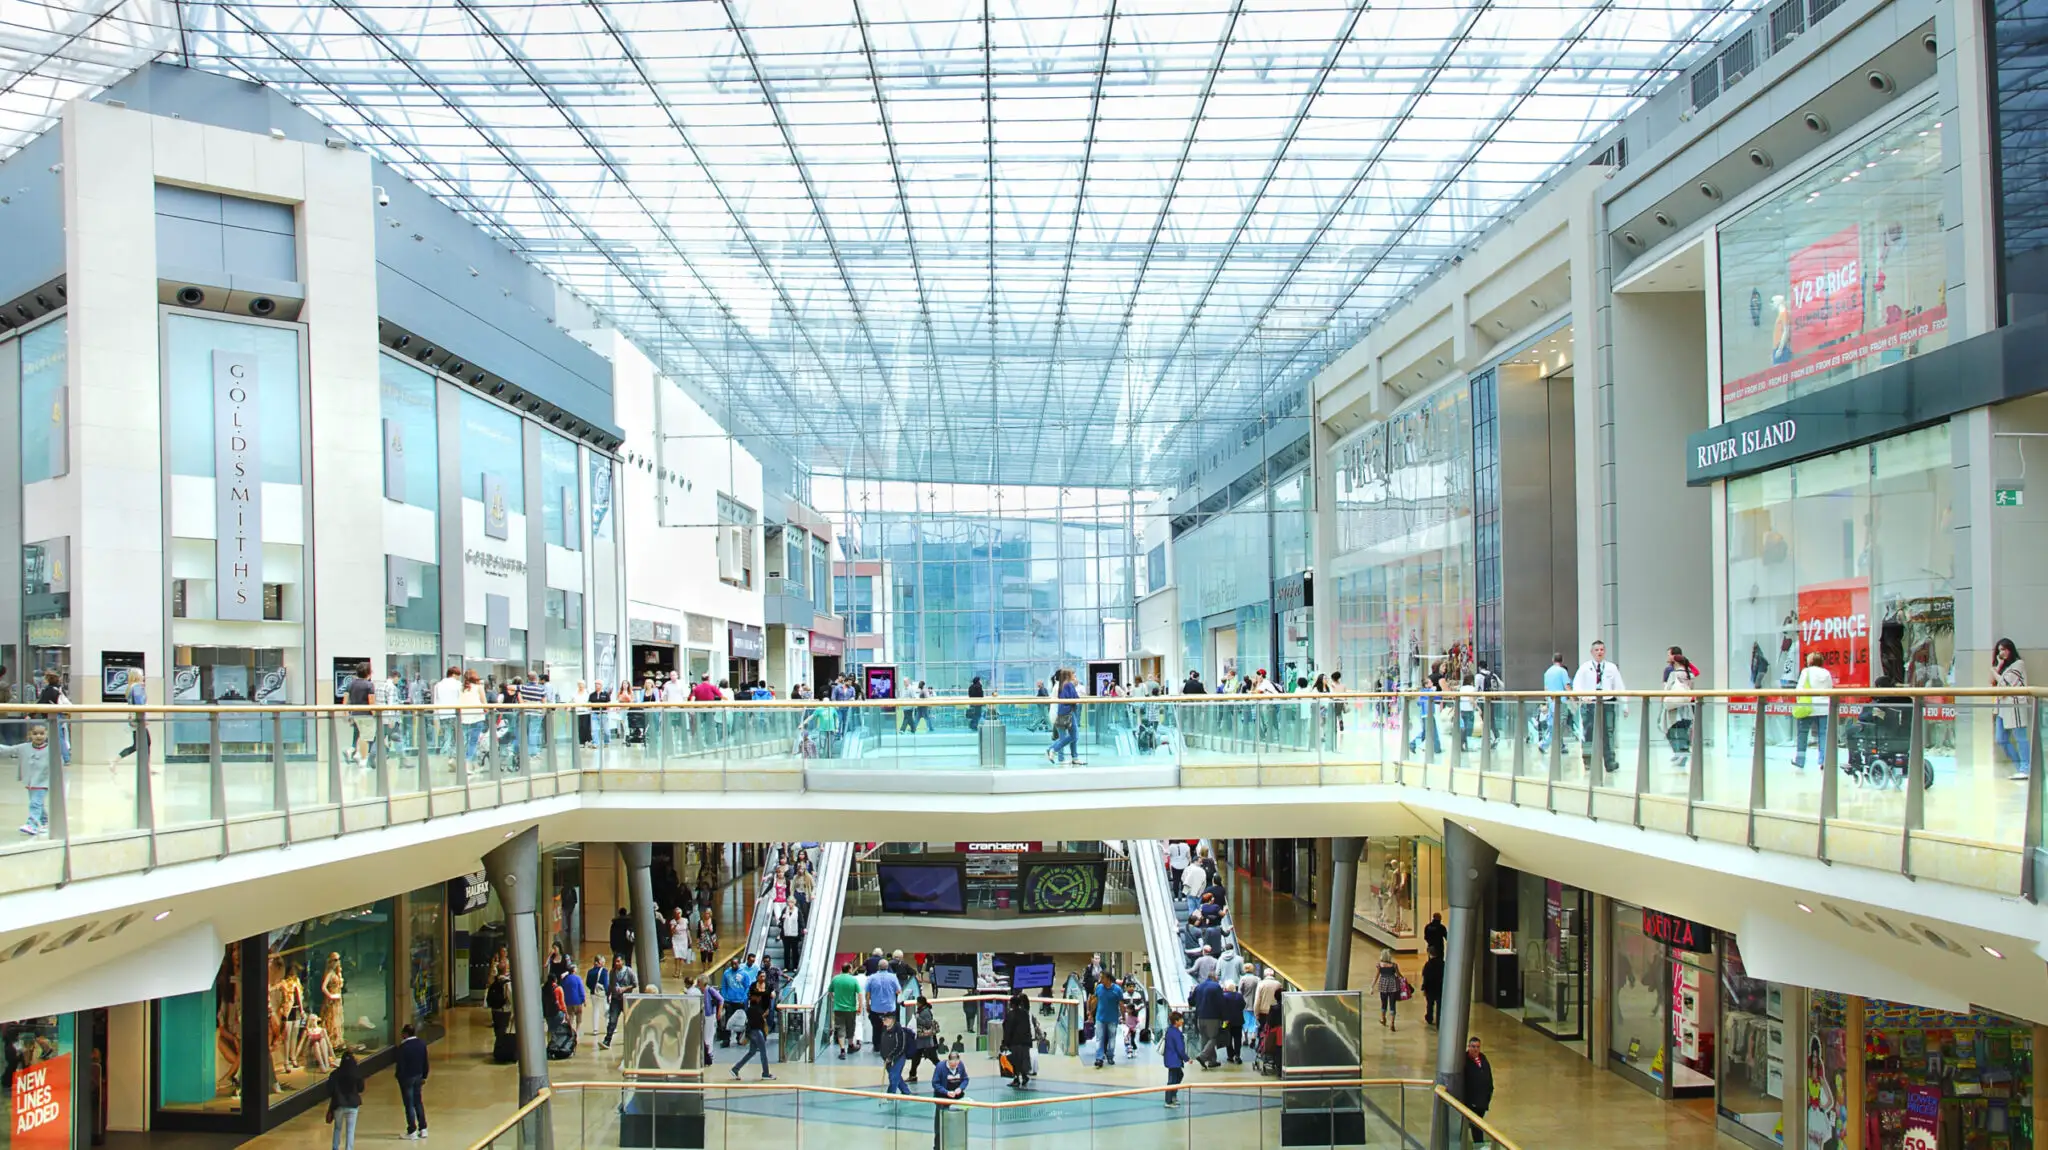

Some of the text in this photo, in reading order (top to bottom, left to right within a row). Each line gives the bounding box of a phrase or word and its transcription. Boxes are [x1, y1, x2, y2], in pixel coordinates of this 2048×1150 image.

[1793, 260, 1858, 309] 1/2 PRICE
[1870, 339, 1887, 352] FROM
[1899, 328, 1918, 342] FROM
[1697, 419, 1796, 468] RIVER ISLAND
[229, 364, 250, 604] GOLDSMITHS
[1802, 613, 1867, 647] 1/2 PRICE
[968, 842, 1029, 852] cranberry
[465, 881, 489, 898] HALIFAX
[16, 1067, 47, 1095] NEW
[17, 1085, 52, 1114] LINES
[17, 1102, 60, 1135] ADDED
